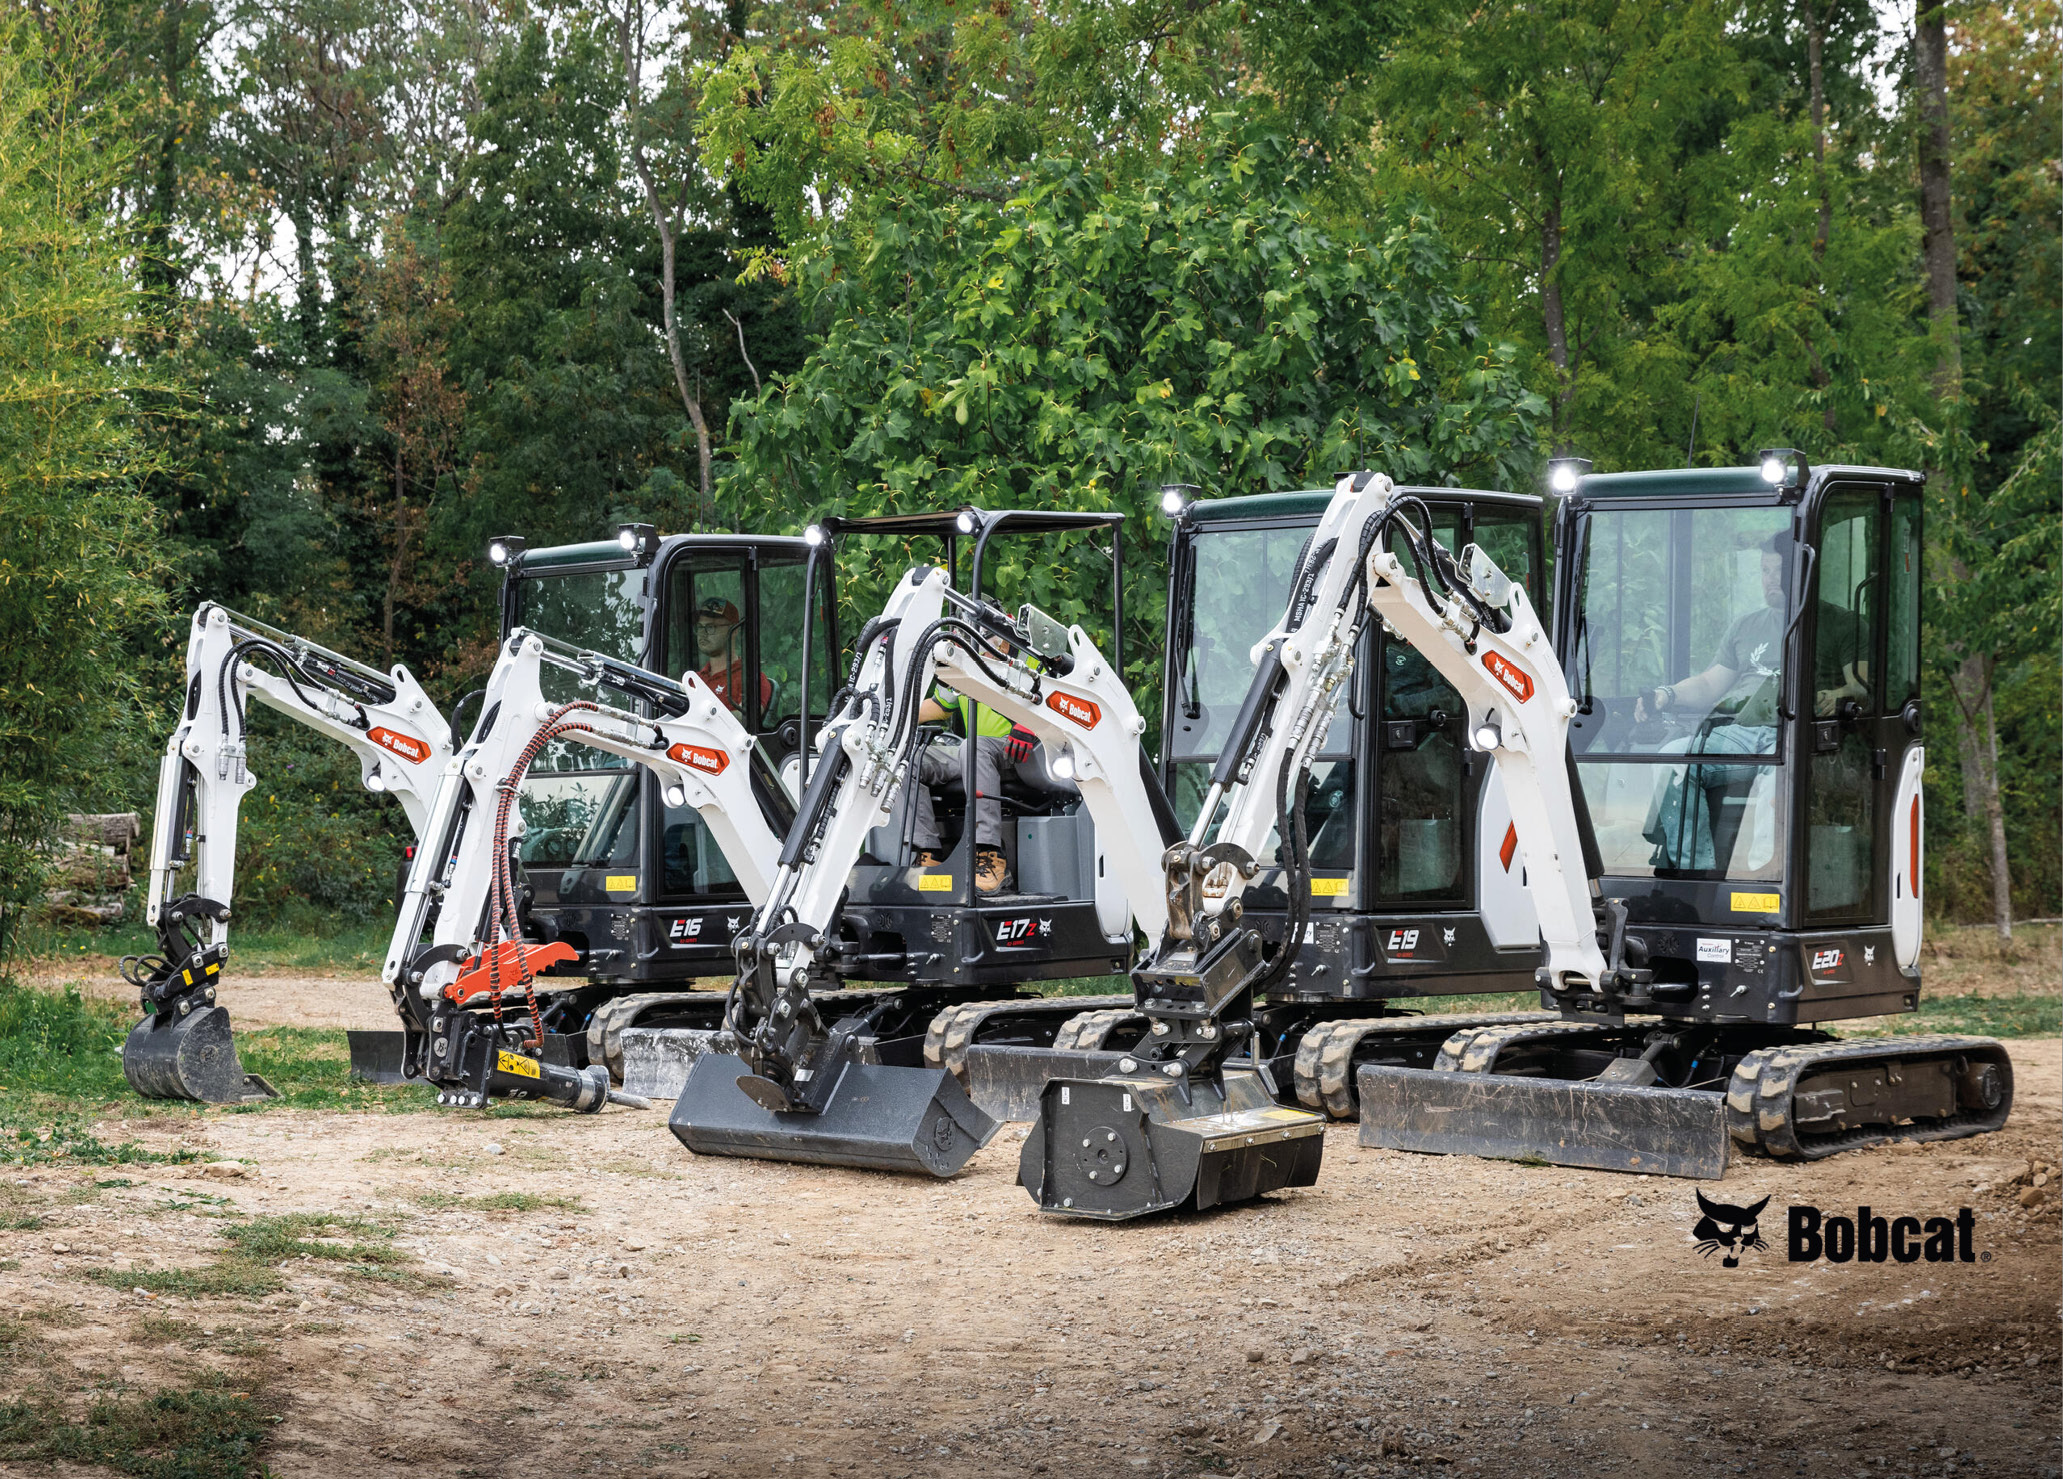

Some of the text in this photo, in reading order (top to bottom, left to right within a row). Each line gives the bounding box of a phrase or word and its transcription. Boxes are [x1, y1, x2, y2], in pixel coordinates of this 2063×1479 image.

[1503, 668, 1525, 696] Bobcat
[1069, 703, 1092, 723] Bobcat
[393, 739, 419, 758] Bobcat
[693, 752, 718, 769] Bobcat
[669, 918, 703, 938] E16
[1387, 929, 1420, 950] E19
